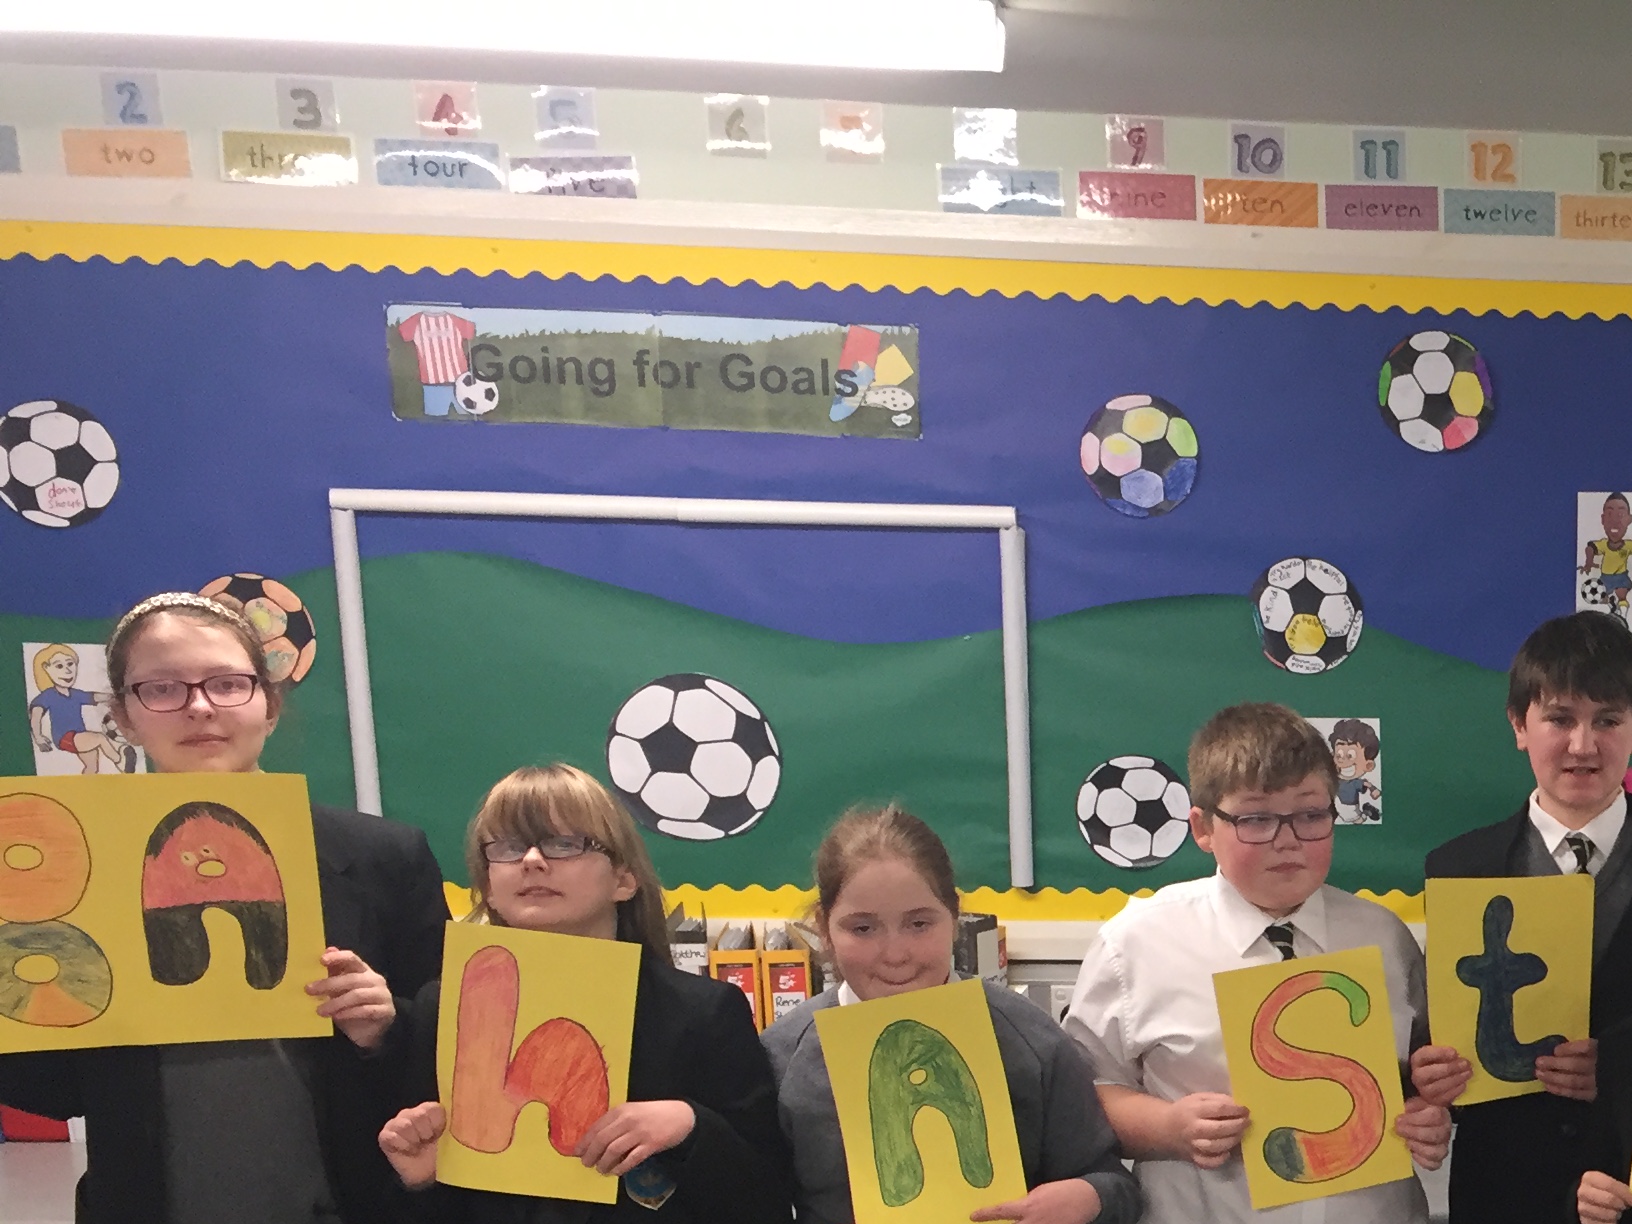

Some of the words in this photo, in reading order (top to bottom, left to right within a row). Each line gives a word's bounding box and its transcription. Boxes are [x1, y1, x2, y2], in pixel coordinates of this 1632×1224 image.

[115, 80, 148, 124] 2
[289, 88, 322, 130] 3
[432, 93, 464, 136] 4
[101, 143, 156, 165] two
[1127, 126, 1148, 166] 9
[1233, 133, 1284, 175] 10
[1360, 138, 1400, 180] 11
[1470, 141, 1517, 184] 12
[1238, 192, 1287, 215] ten
[1344, 201, 1421, 220] eleven
[1463, 203, 1538, 223] twelve
[470, 343, 617, 398] Going
[633, 349, 702, 387] for
[720, 352, 860, 400] Goals
[1249, 970, 1386, 1184] S
[868, 1018, 994, 1207] A
